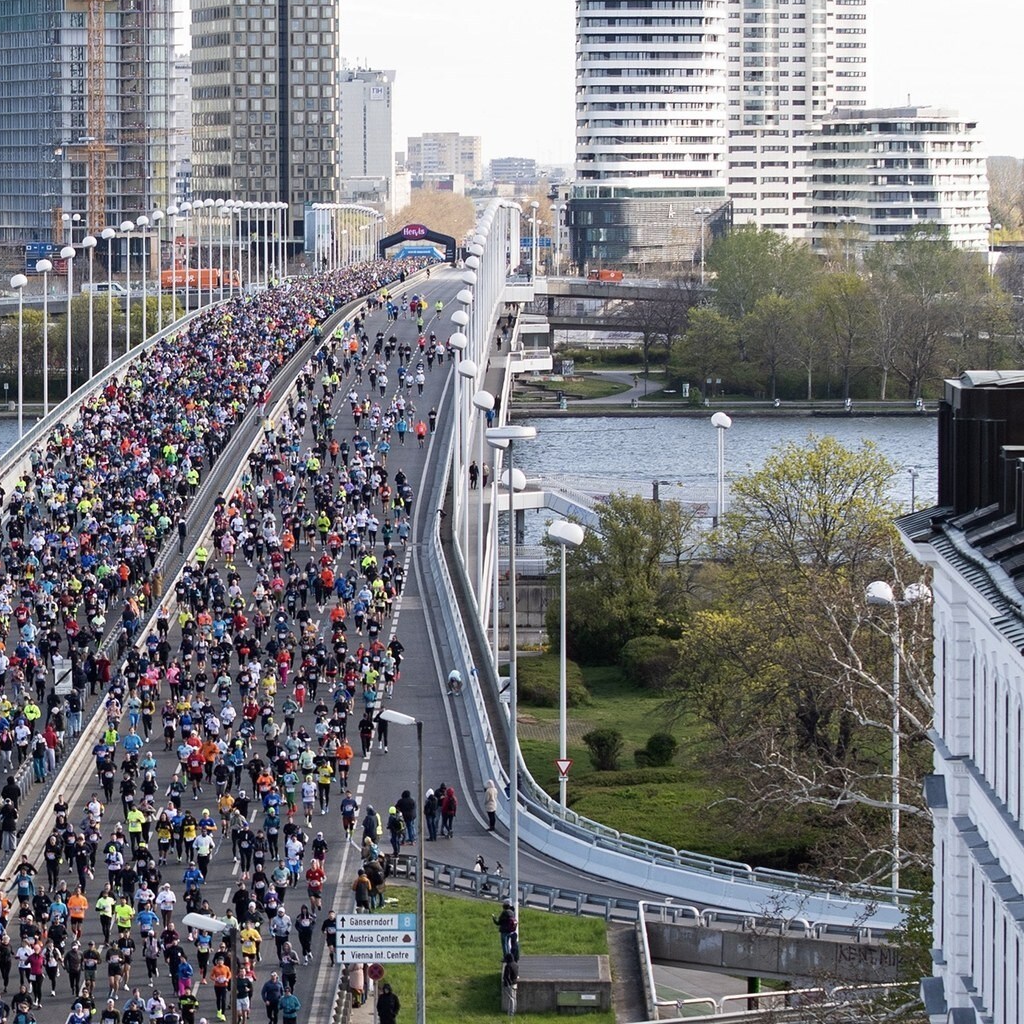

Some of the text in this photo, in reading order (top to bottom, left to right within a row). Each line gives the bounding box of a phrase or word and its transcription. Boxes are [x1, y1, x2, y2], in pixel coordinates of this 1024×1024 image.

[403, 916, 411, 927] 8
[349, 934, 398, 943] Austria Center
[350, 950, 409, 959] Vienna Int. Centre
